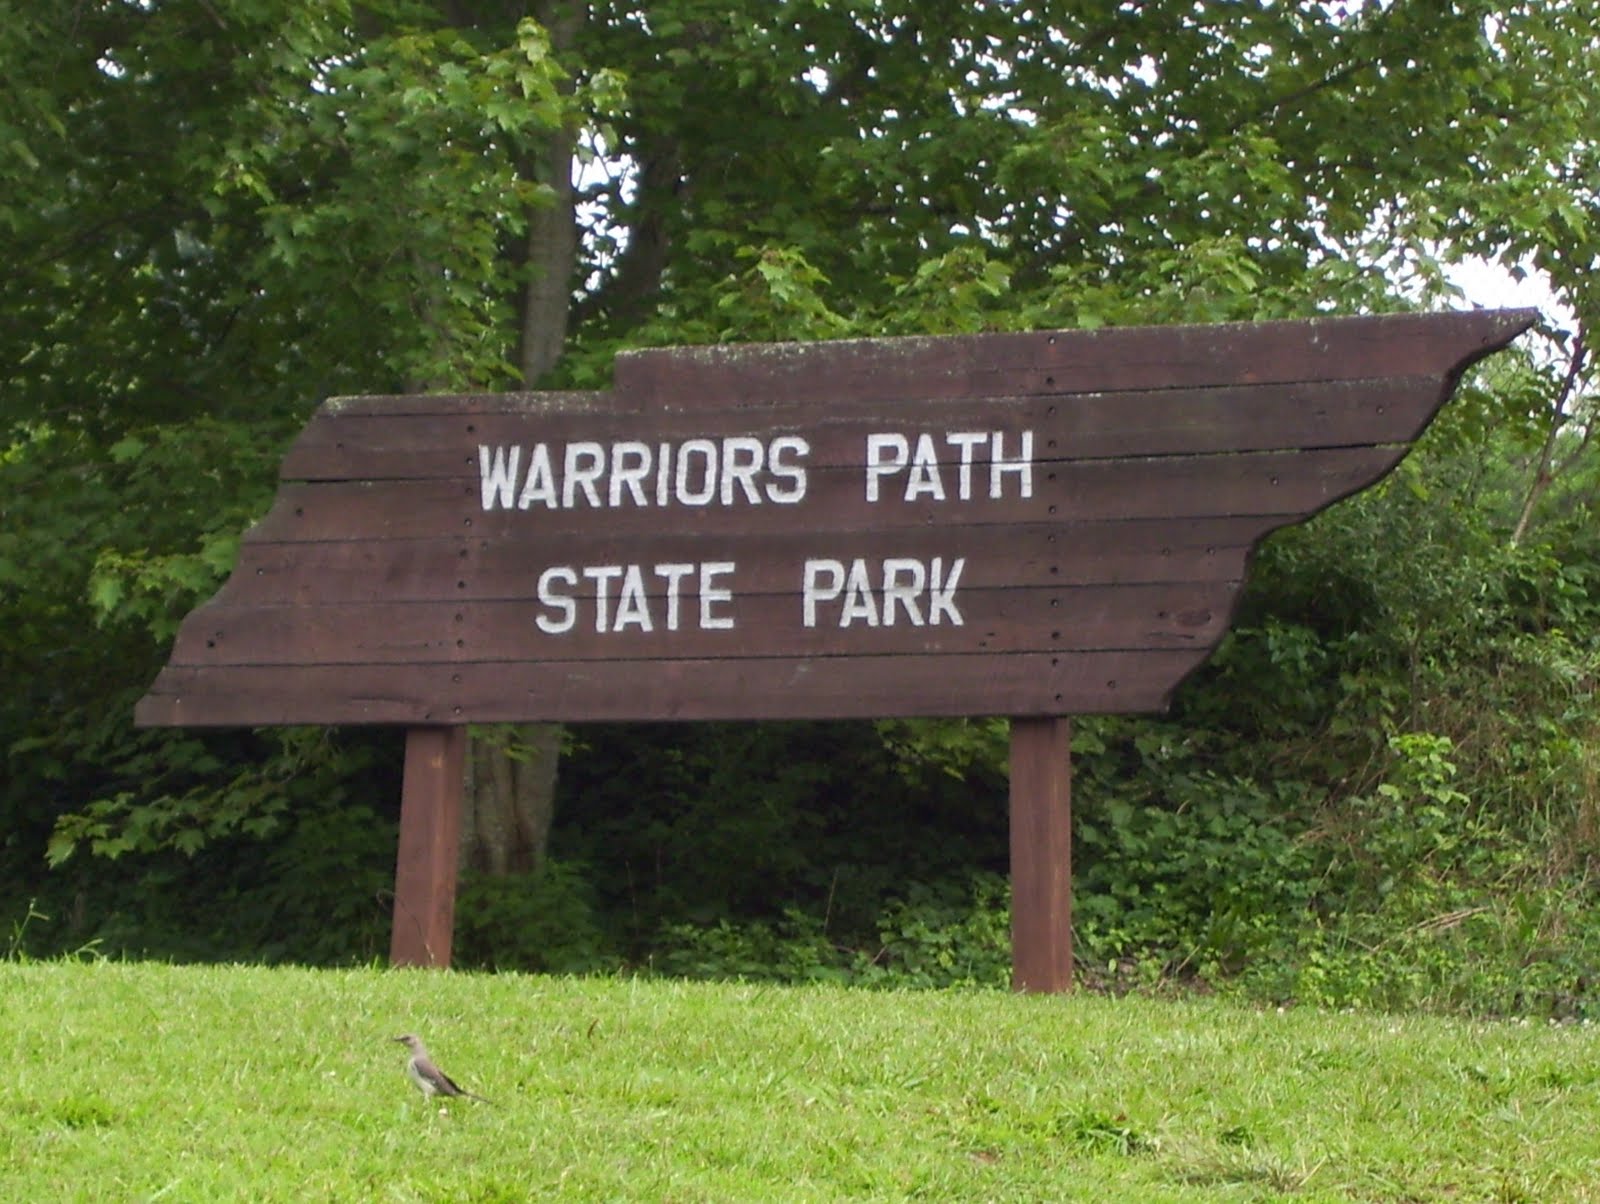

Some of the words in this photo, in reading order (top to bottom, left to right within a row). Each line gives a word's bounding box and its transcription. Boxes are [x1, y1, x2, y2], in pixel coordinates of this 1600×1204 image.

[478, 436, 811, 511] WARRIORS
[866, 430, 1034, 503] PATH
[535, 561, 736, 634] STATE
[803, 556, 966, 628] PARK
